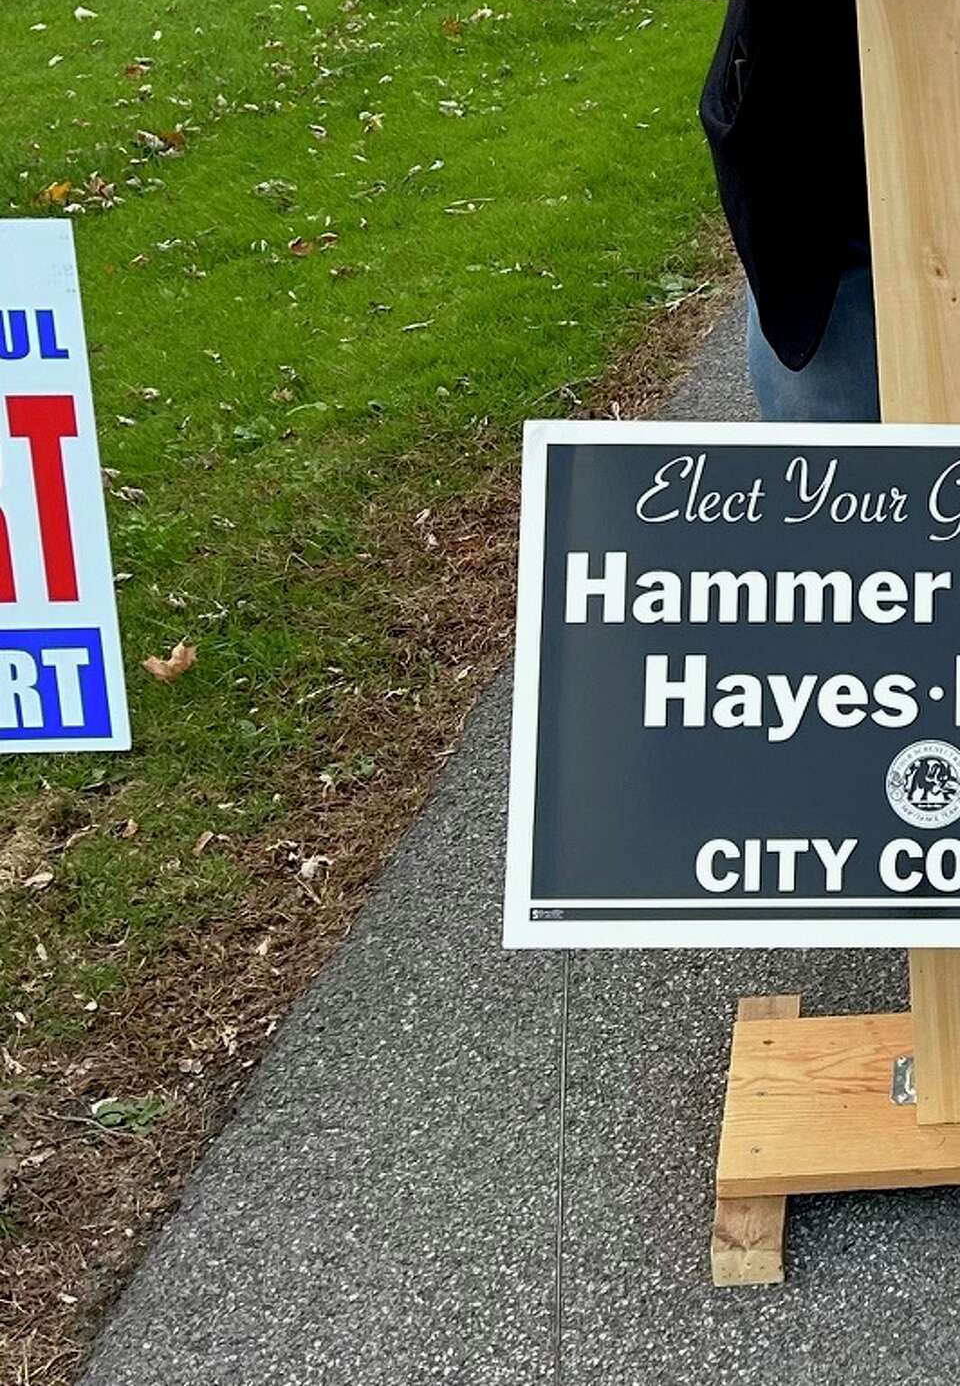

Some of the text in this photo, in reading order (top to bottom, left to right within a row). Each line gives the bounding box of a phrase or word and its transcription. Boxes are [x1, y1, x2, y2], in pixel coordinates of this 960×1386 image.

[0, 395, 79, 603] T
[636, 453, 766, 523] Elect
[783, 457, 908, 524] Your
[695, 838, 858, 893] CITY
